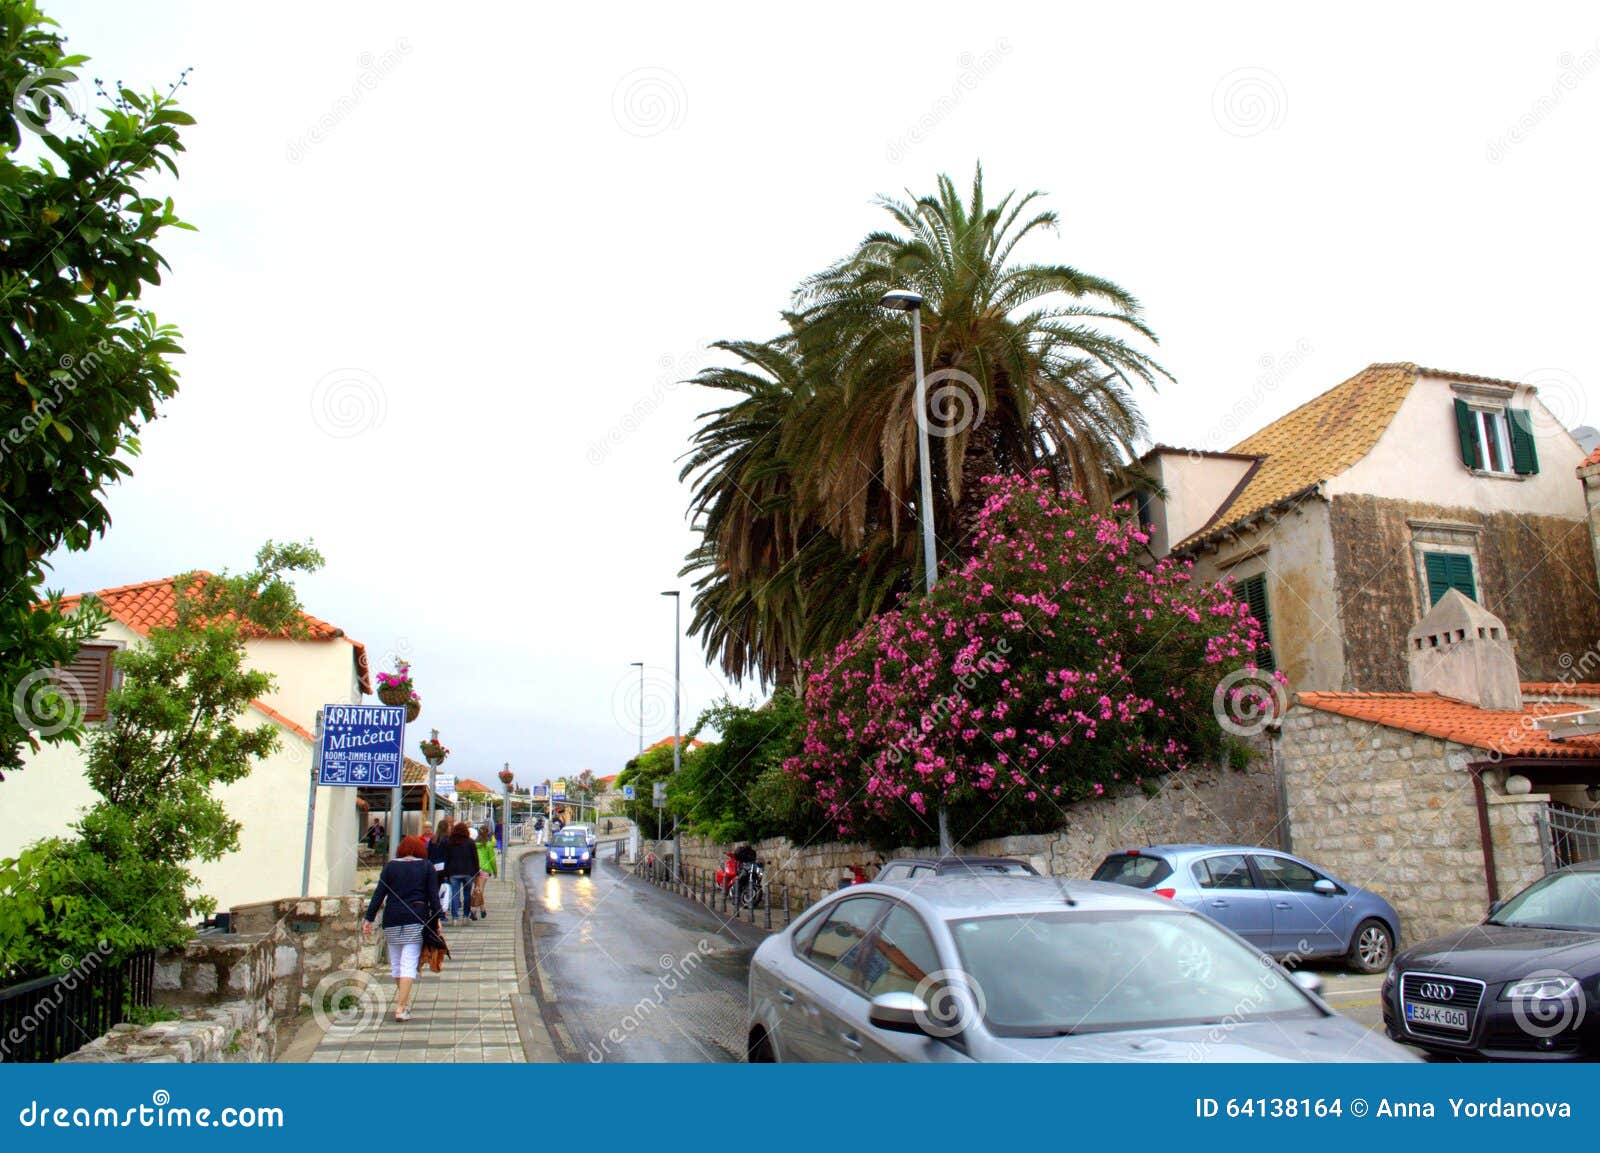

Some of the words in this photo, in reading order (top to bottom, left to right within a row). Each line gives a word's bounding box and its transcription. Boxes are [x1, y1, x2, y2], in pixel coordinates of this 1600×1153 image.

[328, 708, 401, 727] APARTMENTS
[329, 729, 396, 750] Minčeta
[1413, 1007, 1465, 1026] E34-K-060
